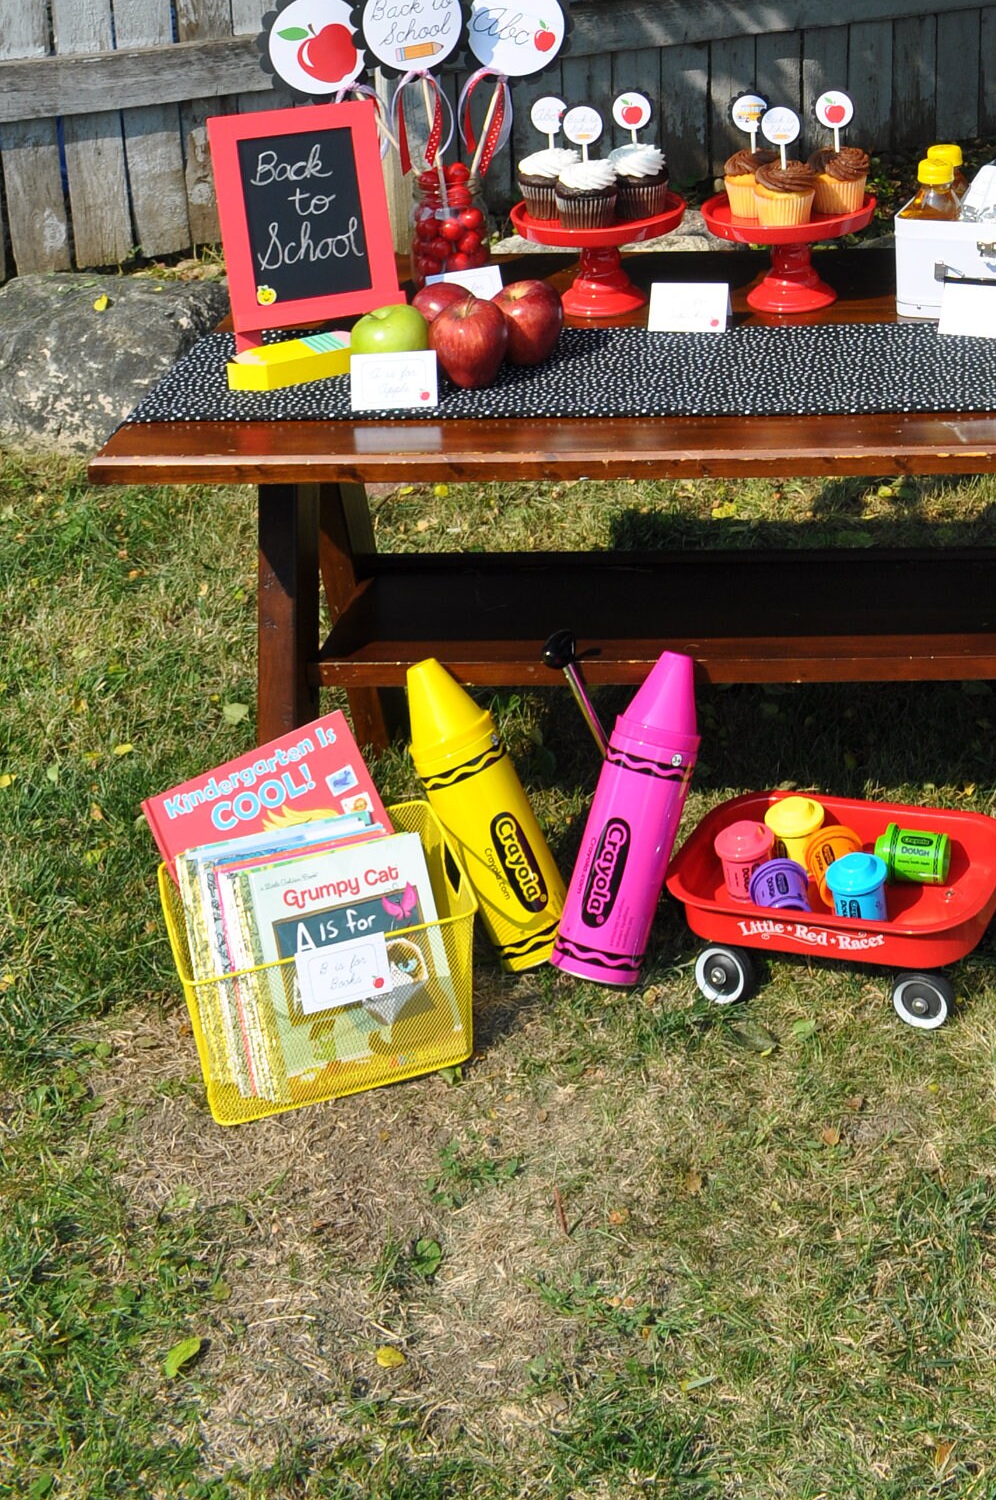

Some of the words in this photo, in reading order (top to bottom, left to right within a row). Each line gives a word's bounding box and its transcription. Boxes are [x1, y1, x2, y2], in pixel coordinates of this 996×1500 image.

[379, 11, 452, 47] School
[250, 143, 334, 187] Back
[287, 188, 336, 216] to
[257, 216, 365, 272] School
[163, 738, 315, 820] Kindergarten
[315, 726, 338, 749] Is
[211, 763, 316, 832] COOL!
[484, 847, 511, 901] Crayola.com
[495, 817, 541, 902] Crayola
[587, 823, 628, 916] Crayola
[283, 877, 361, 909] Grumpy
[364, 866, 399, 886] Cat
[296, 921, 317, 953] A
[345, 909, 376, 934] for
[737, 920, 785, 936] Little
[794, 924, 828, 946] Red
[836, 934, 886, 950] Racer
